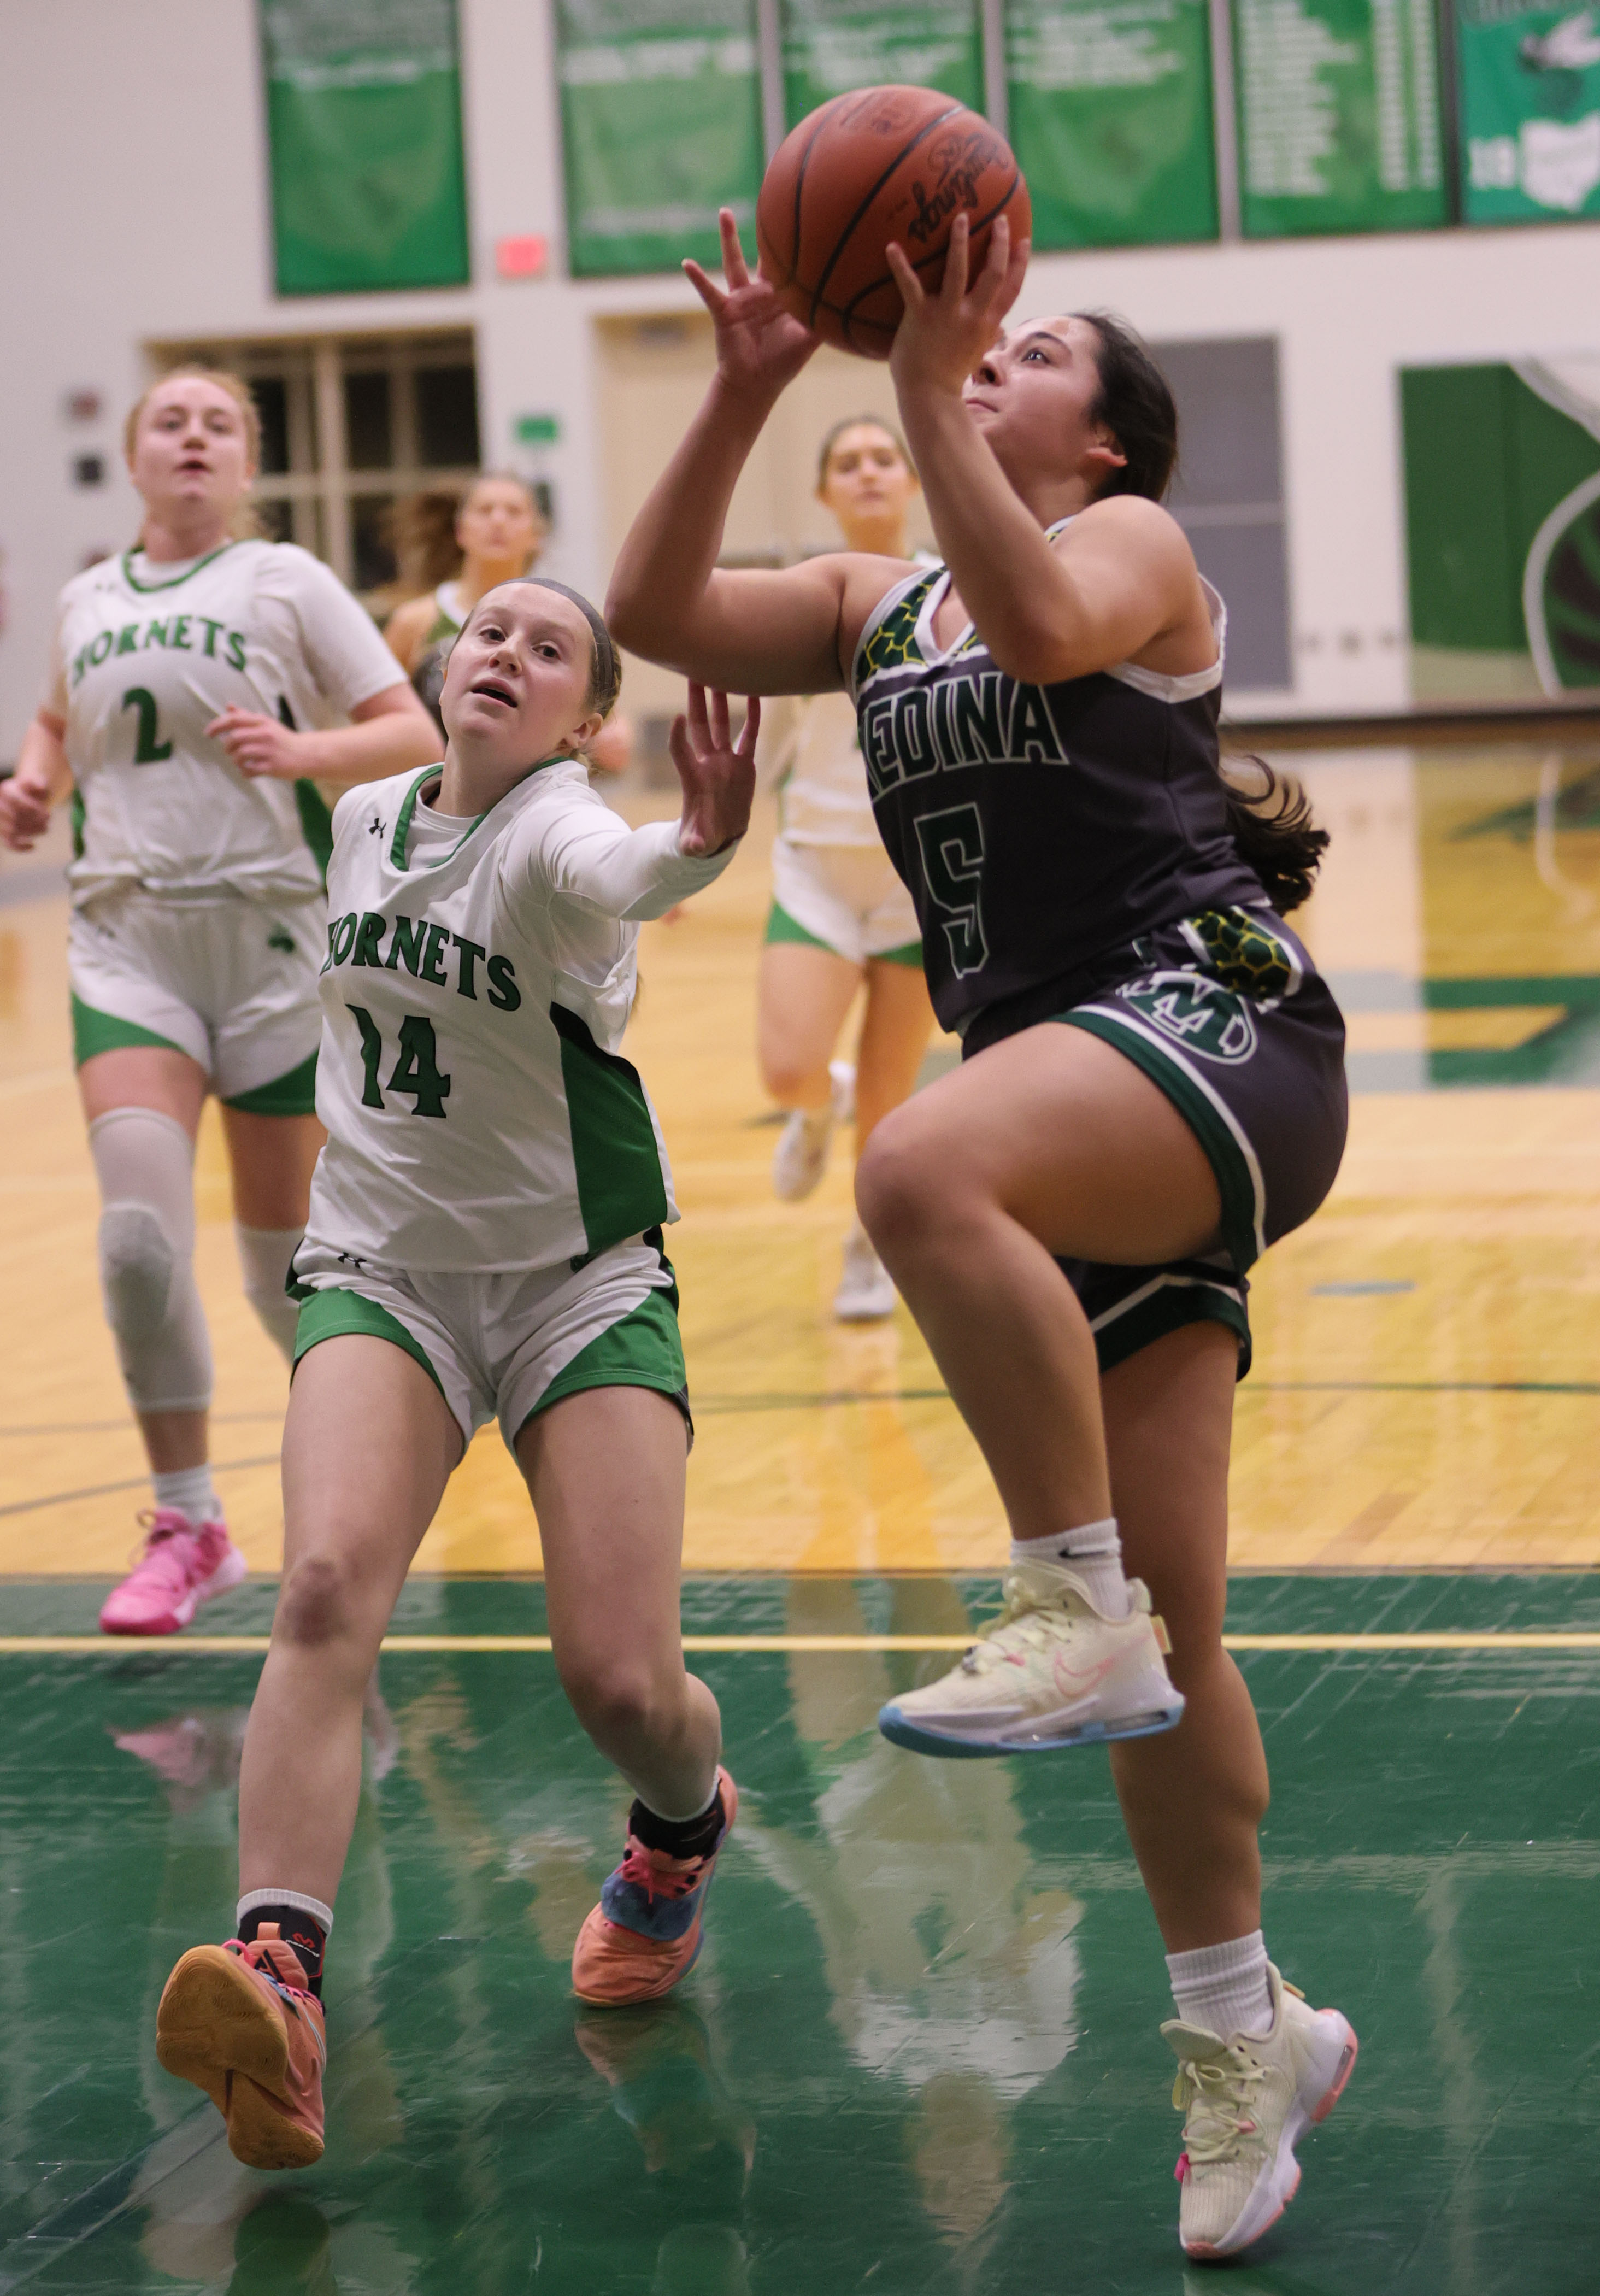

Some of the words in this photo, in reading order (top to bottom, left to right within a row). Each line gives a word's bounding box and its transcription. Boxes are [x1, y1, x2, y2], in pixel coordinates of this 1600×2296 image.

[121, 687, 174, 764] 2
[860, 671, 1069, 803] EDINA
[913, 802, 989, 980] 5
[345, 1003, 451, 1118] 14
